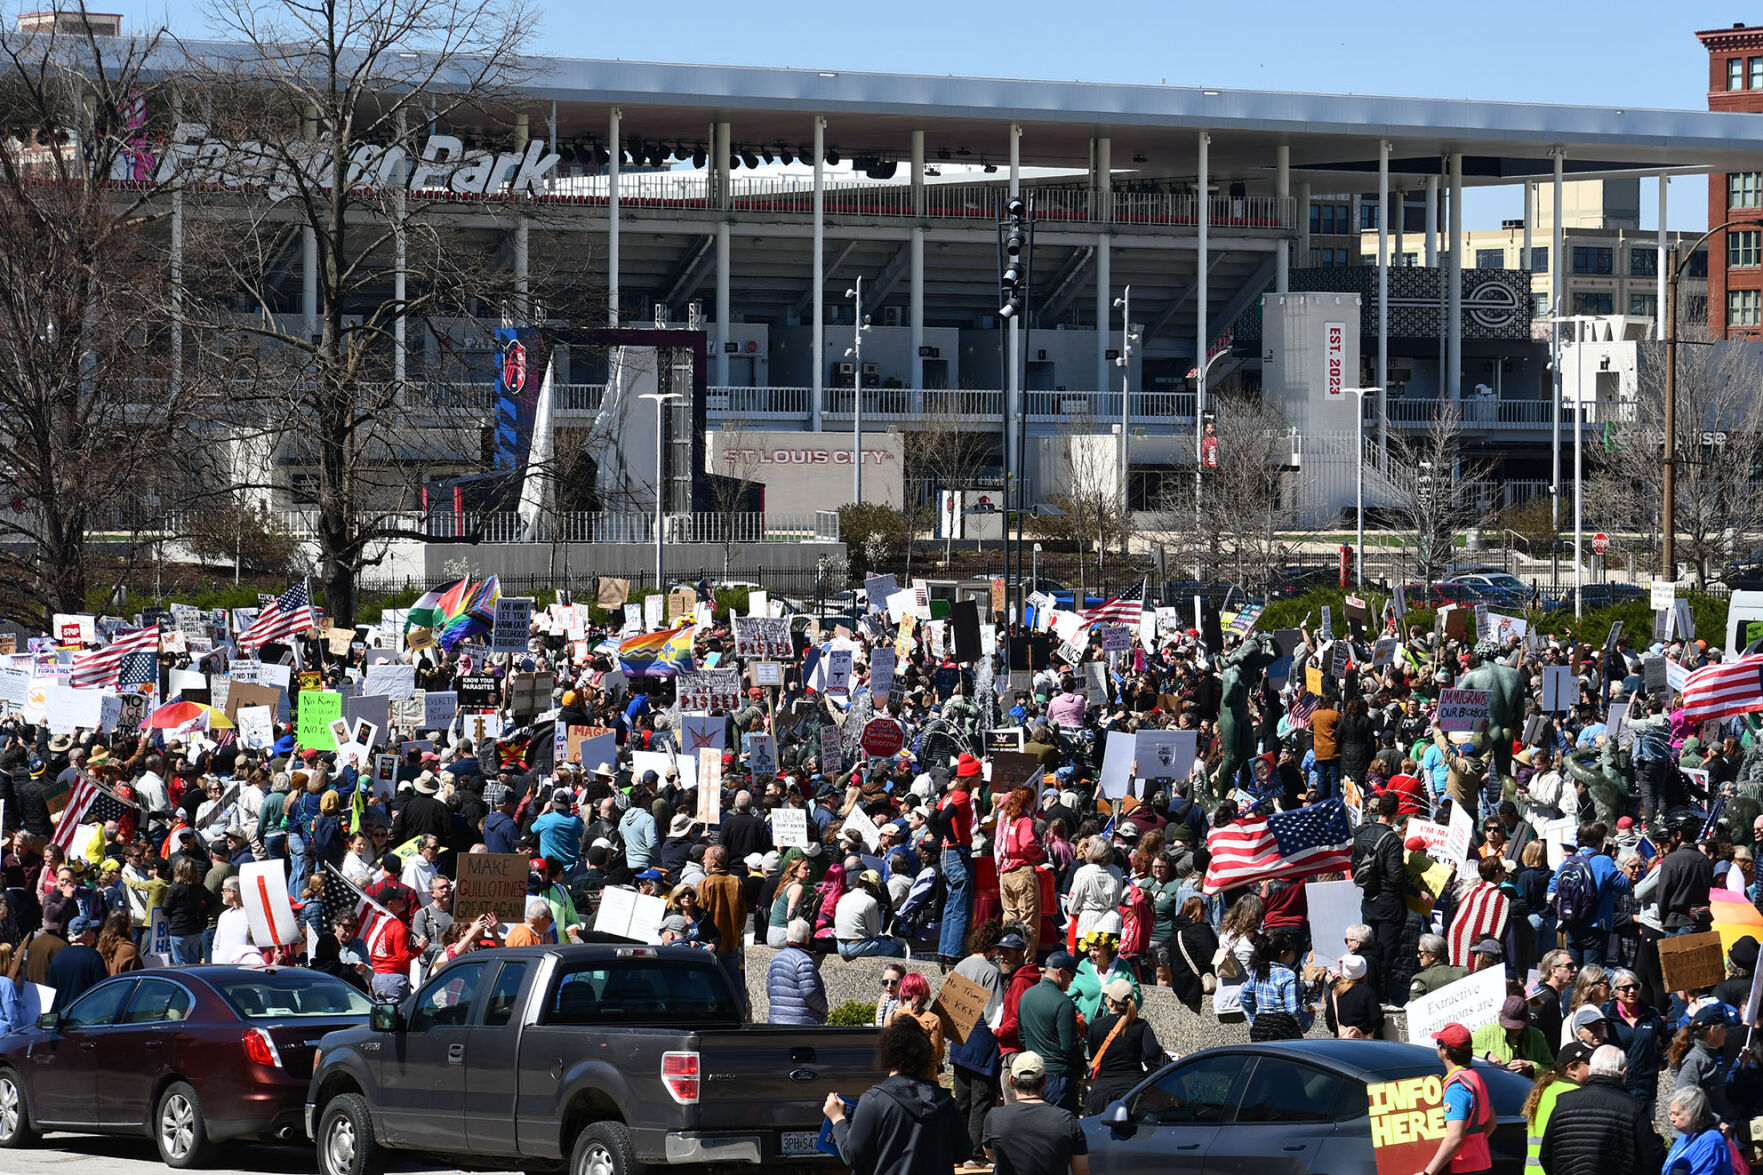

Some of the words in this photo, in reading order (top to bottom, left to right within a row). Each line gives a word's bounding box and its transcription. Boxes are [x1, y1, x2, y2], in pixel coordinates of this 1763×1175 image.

[410, 135, 561, 196] Park
[1330, 328, 1341, 355] EST.
[1330, 358, 1341, 395] 2023
[723, 449, 754, 463] ST
[760, 449, 830, 464] LOUIS
[833, 449, 887, 464] CITY
[63, 627, 80, 636] STOP
[514, 621, 527, 629] OUR
[740, 642, 792, 655] PISSED
[1058, 641, 1081, 664] KINGS
[893, 673, 907, 685] NO
[121, 694, 143, 707] NO
[681, 694, 740, 709] PISSED
[119, 707, 142, 718] ICE
[1441, 707, 1457, 718] OUR
[467, 858, 512, 876] MAKE
[458, 879, 526, 898] GUILLOTINES
[457, 901, 491, 919] GREAT
[494, 901, 524, 918] AGAIN
[946, 977, 957, 989] No
[962, 985, 984, 1004] Trump
[938, 992, 949, 1003] No
[954, 1000, 976, 1018] KKK
[1427, 985, 1480, 1016] Extractive
[1418, 1005, 1473, 1039] institutions
[1477, 998, 1494, 1013] are
[1367, 1075, 1442, 1117] INFO
[1370, 1107, 1448, 1149] HERE
